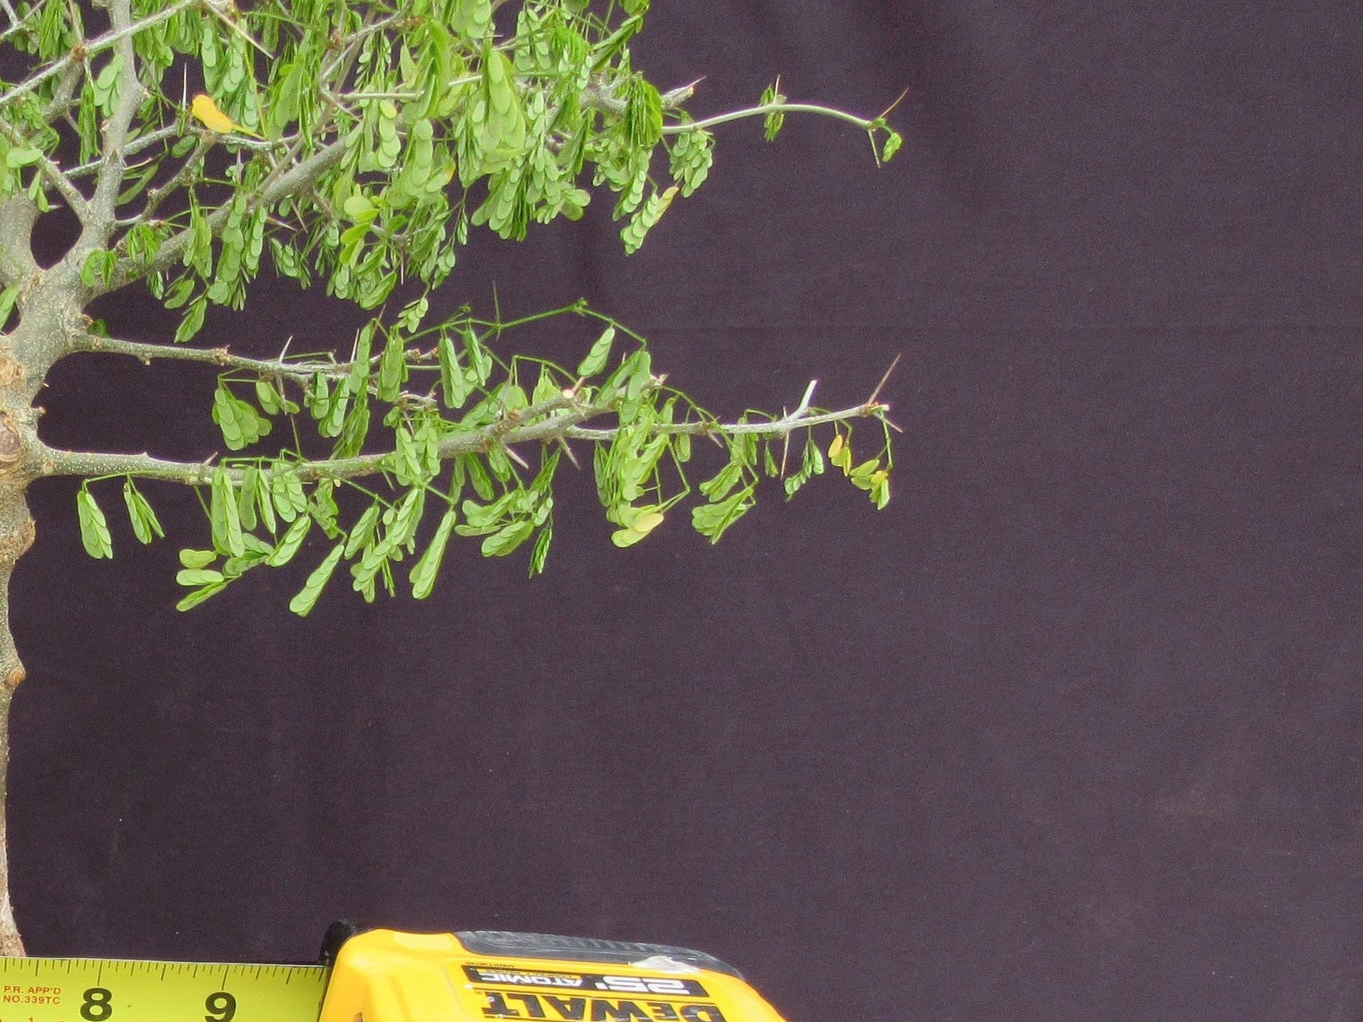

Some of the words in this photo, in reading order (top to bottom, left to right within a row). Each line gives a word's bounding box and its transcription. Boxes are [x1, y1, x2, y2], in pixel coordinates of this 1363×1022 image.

[481, 973, 583, 988] ATOMIC
[3, 985, 24, 994] P.R.
[27, 986, 62, 995] APP'D
[80, 987, 113, 1022] 8
